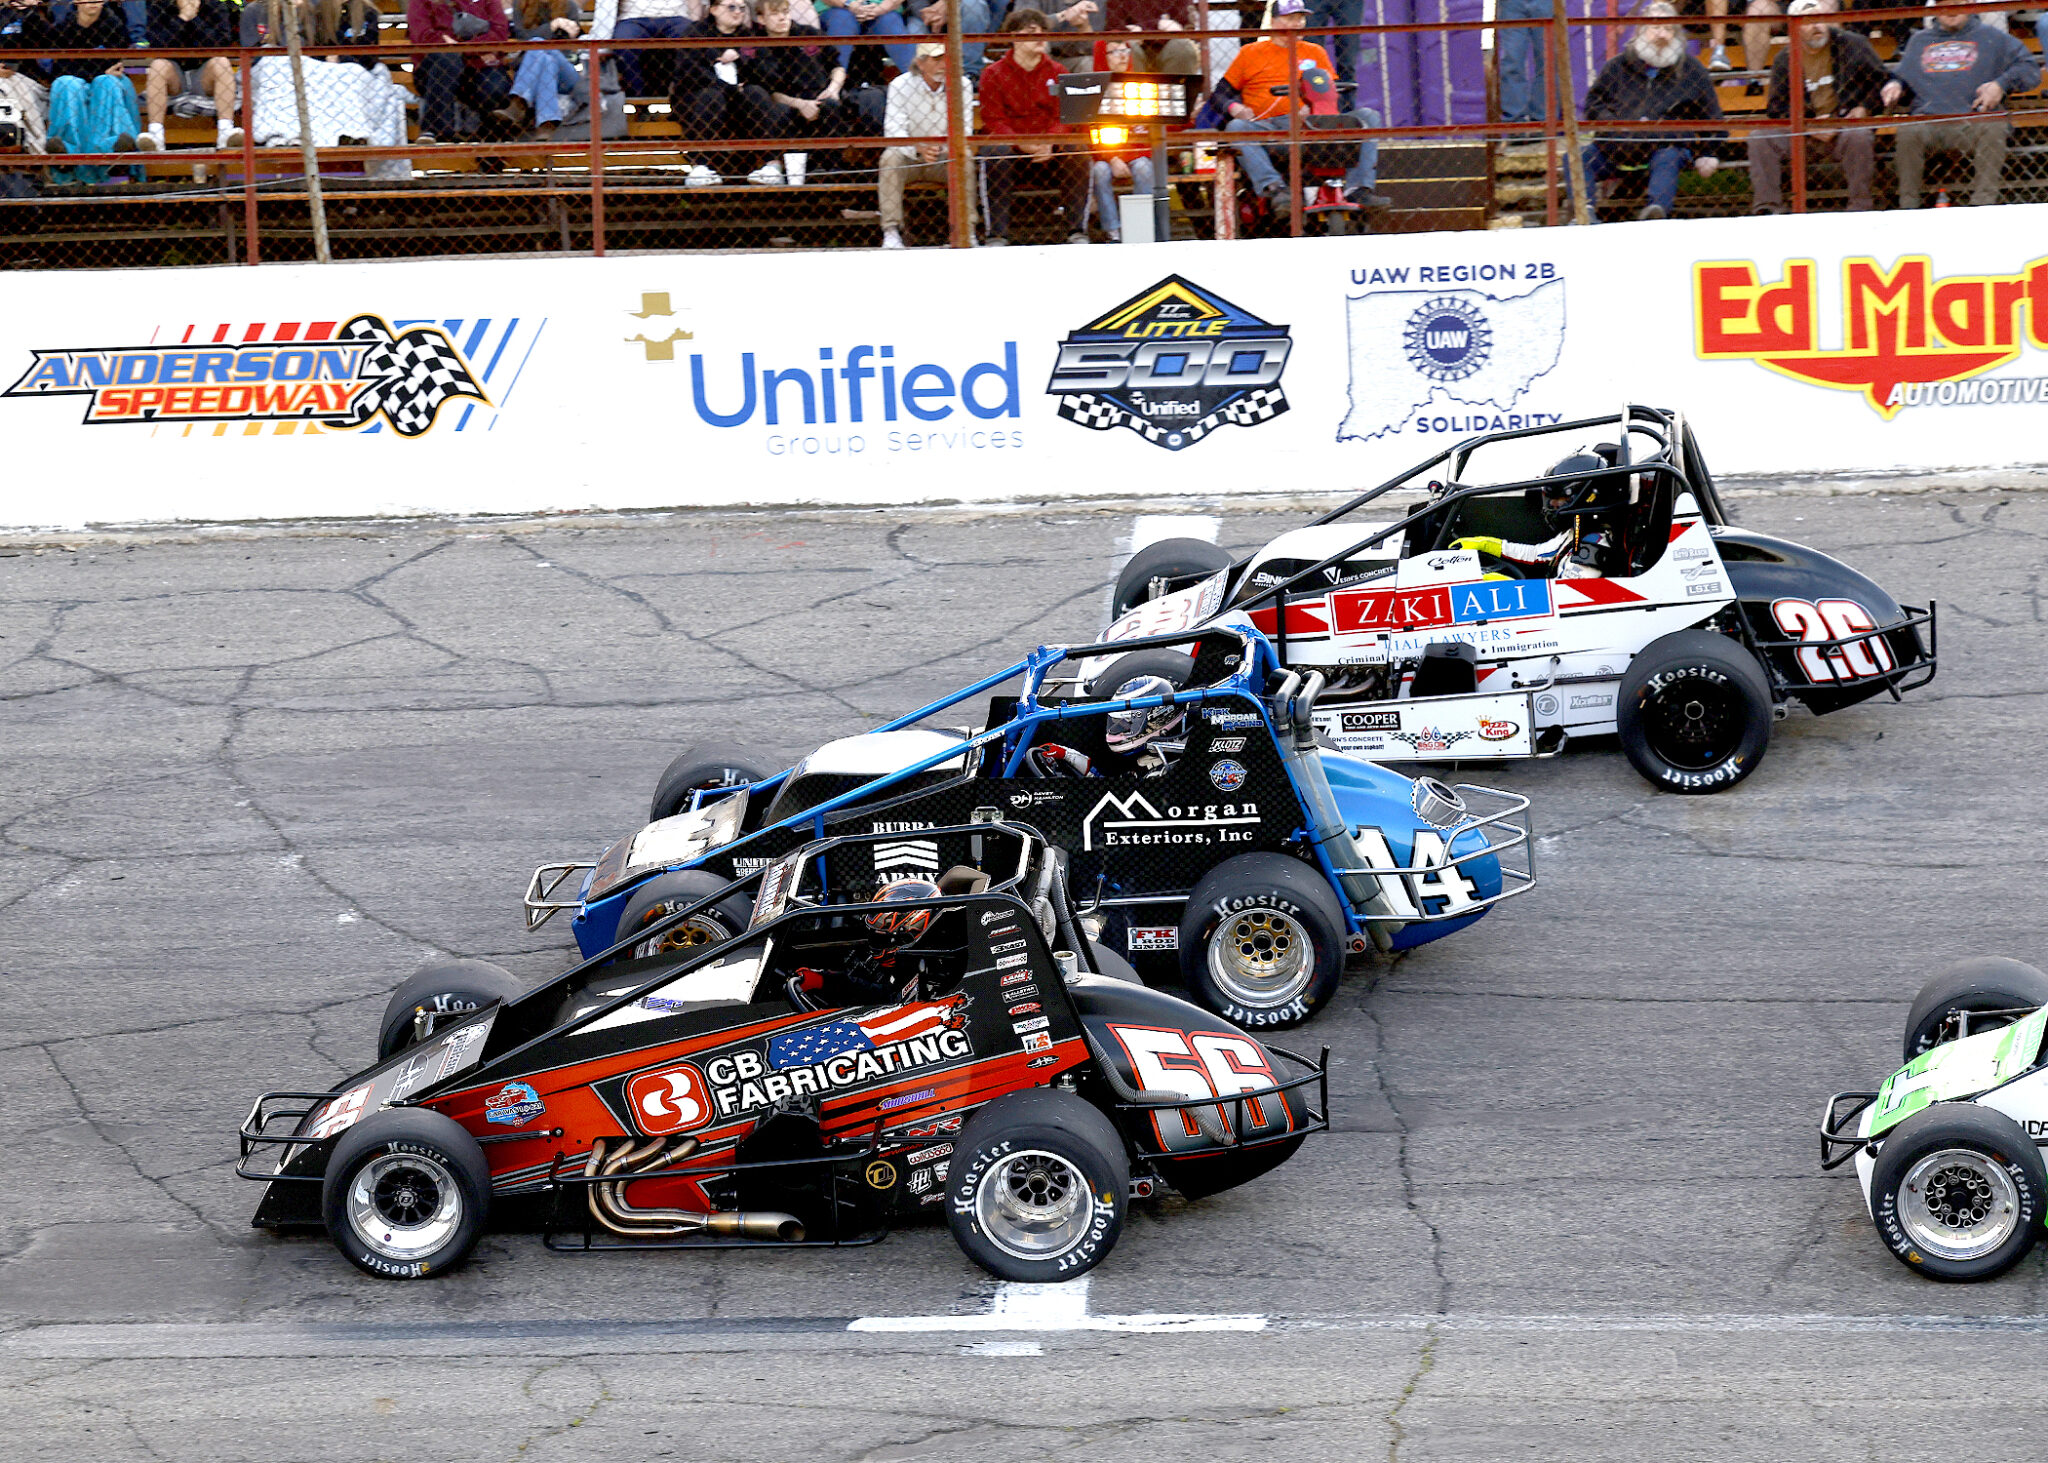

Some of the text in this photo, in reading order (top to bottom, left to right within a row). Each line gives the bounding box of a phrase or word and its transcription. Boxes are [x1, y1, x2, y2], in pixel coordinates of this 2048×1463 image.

[1351, 262, 1556, 285] UAW REGION 2B
[1697, 262, 1813, 356] Ed
[1123, 320, 1232, 338] LITTLE
[1426, 331, 1469, 349] UAW
[23, 349, 364, 388] ANDERSON
[1049, 338, 1291, 391] 500
[95, 383, 368, 416] SPEEDWAY
[690, 341, 1021, 428] Unified
[1885, 378, 2048, 406] AUTOMOTIVE
[1141, 400, 1200, 415] Unified
[1416, 413, 1563, 433] SOLIDARITY
[766, 427, 1025, 456] Group Services
[1427, 555, 1472, 567] Colton
[1357, 586, 1528, 624] ZAKI ALI
[1338, 654, 1385, 666] Criminal
[1491, 639, 1559, 654] Immigration
[1770, 598, 1896, 684] 26
[1647, 663, 1728, 694] Hoosier
[1211, 713, 1257, 725] MORGAN
[1222, 720, 1264, 731] RACING
[1343, 713, 1398, 726] COOPER
[1481, 721, 1509, 729] Pizza
[1486, 728, 1510, 737] King
[1213, 740, 1242, 749] KLOTZ
[1661, 755, 1743, 786] Hoosier
[1105, 829, 1254, 846] Exteriors, Inc
[1353, 825, 1483, 917] 14
[1213, 890, 1301, 922] Hoosier
[1136, 929, 1174, 938] FK
[1222, 993, 1310, 1028] Hoosier
[708, 1051, 765, 1085] CB
[716, 1030, 970, 1115] FABRICATING
[1106, 1023, 1296, 1161] 56
[387, 1142, 448, 1165] Hoosier
[955, 1140, 1011, 1217] Hoosier
[2004, 1162, 2034, 1223] Hoosier
[1058, 1196, 1114, 1274] Hoosier
[1876, 1192, 1914, 1256] Hoosier
[360, 1253, 424, 1278] Hoosier
